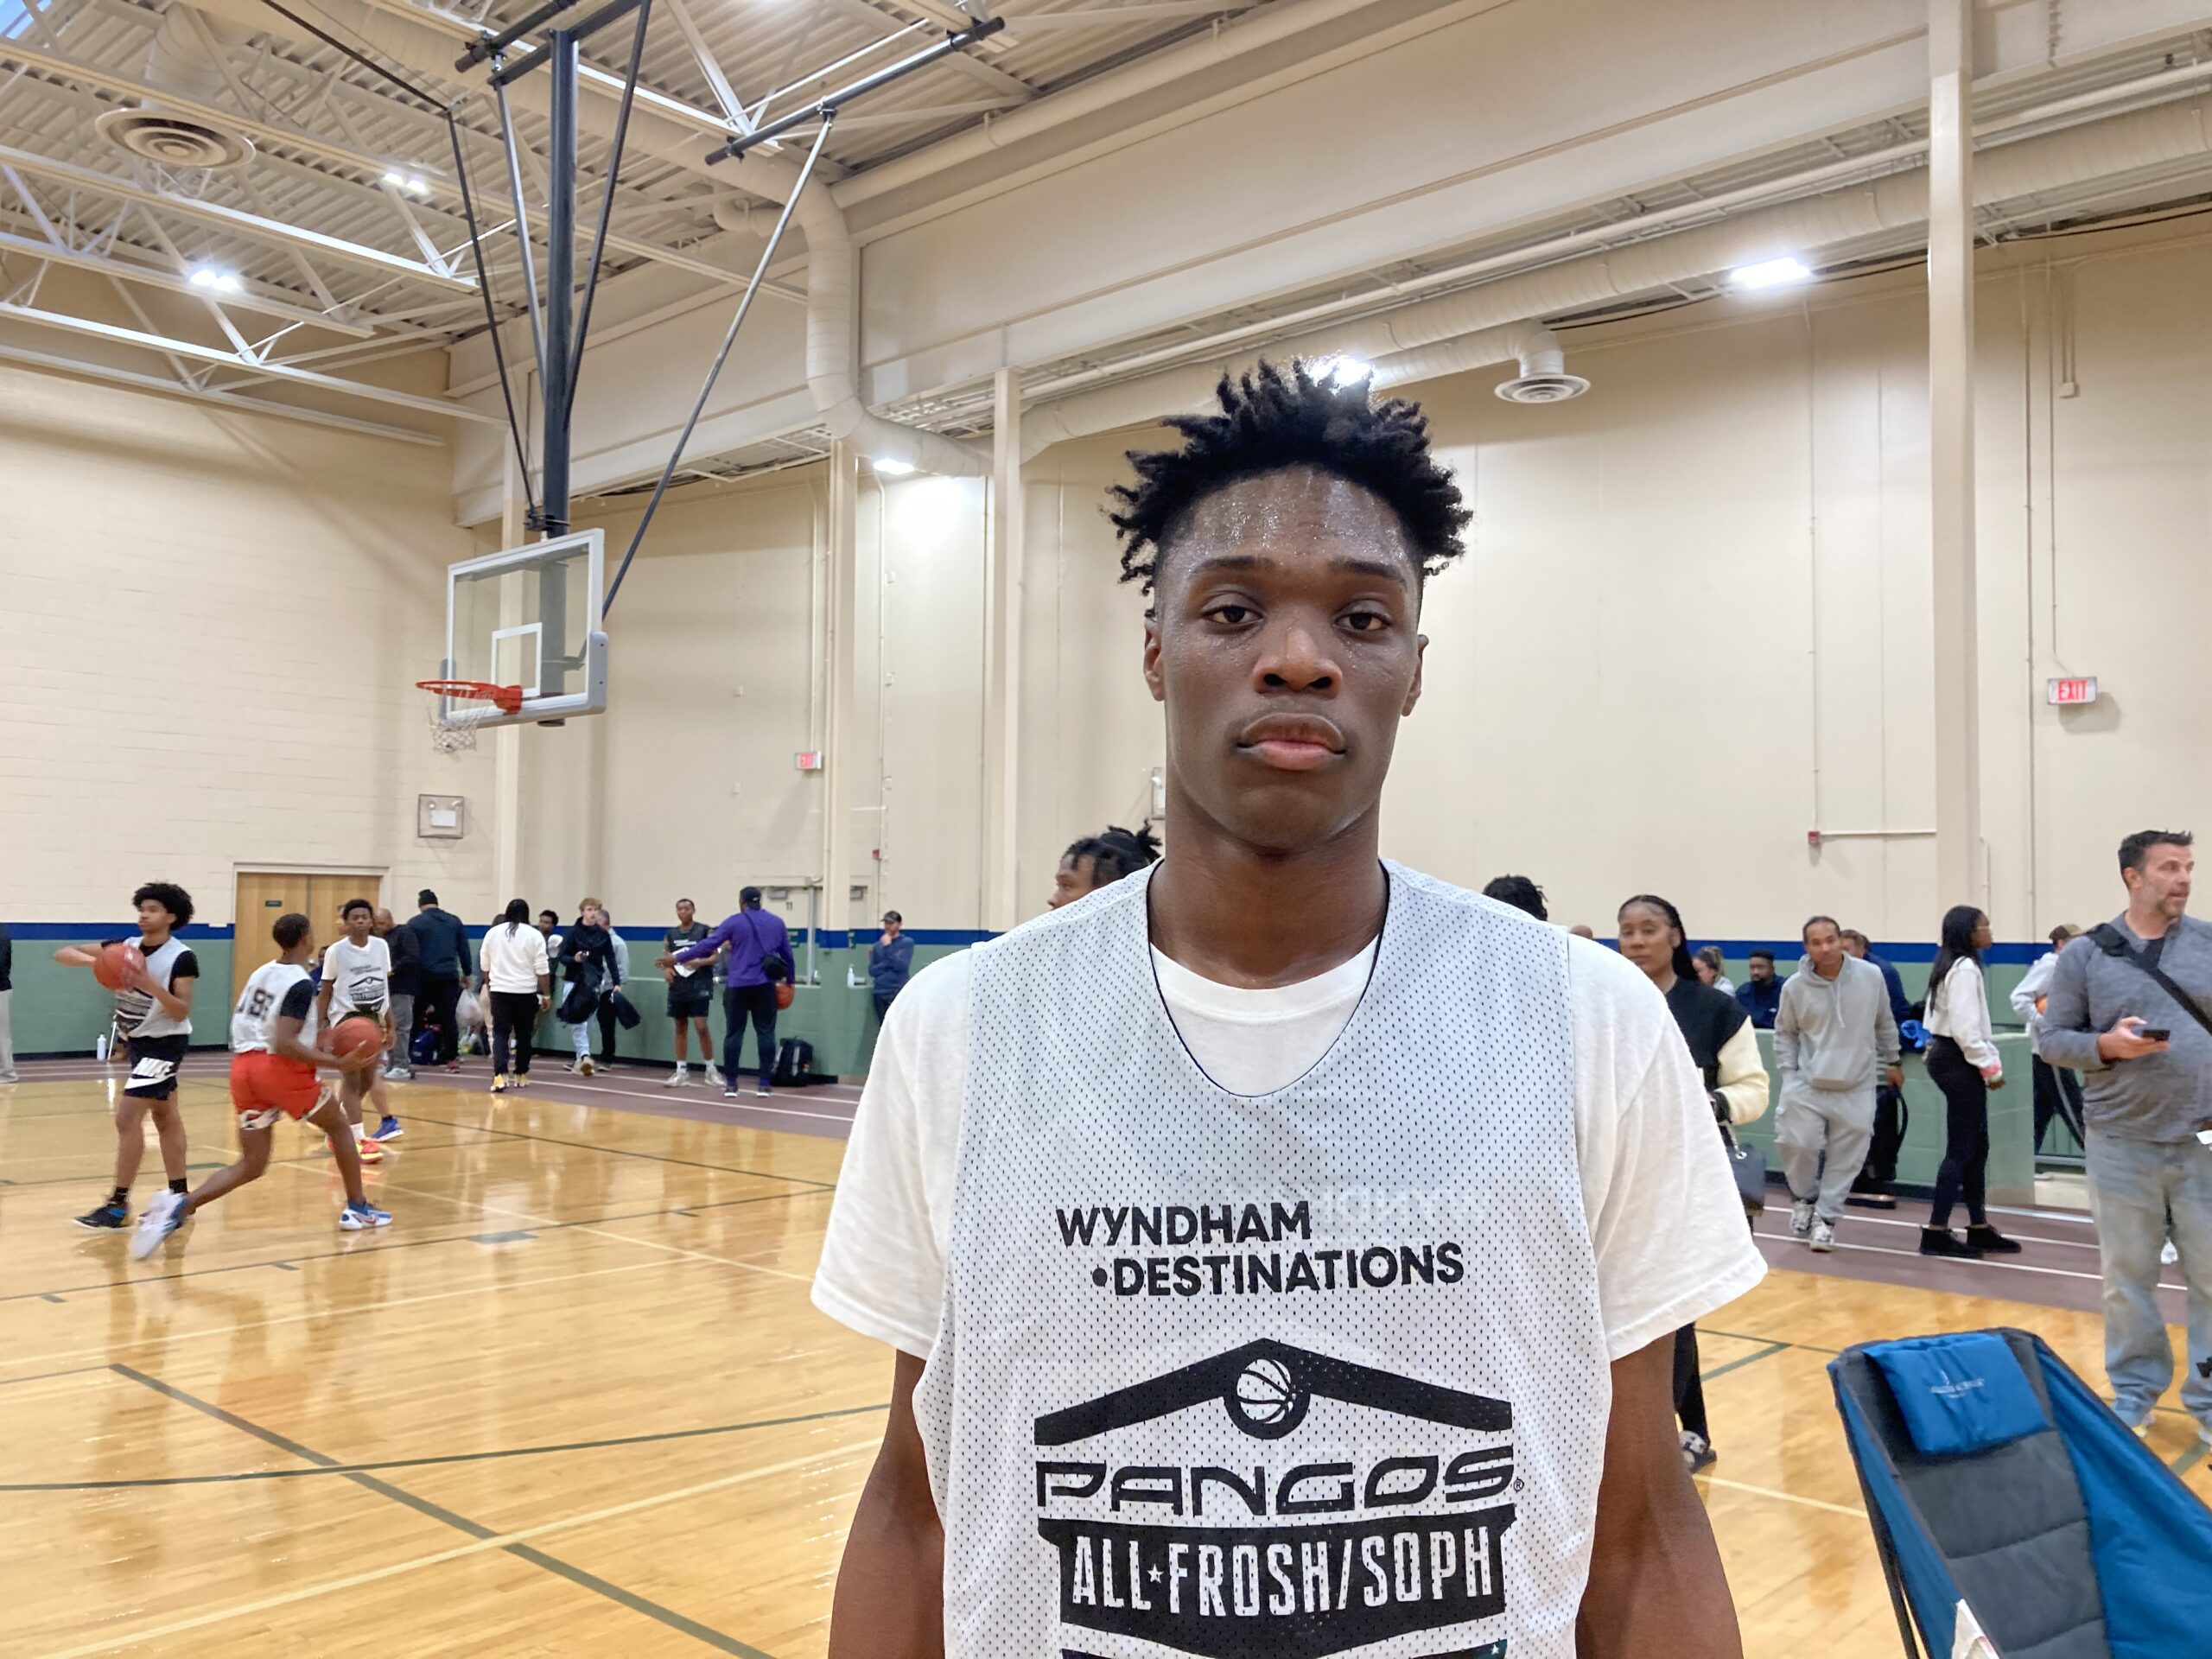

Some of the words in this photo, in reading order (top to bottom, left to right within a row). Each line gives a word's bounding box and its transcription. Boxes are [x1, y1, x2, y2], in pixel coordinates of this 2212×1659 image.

[2057, 679, 2088, 701] EXIT
[1056, 1200, 1313, 1248] WYNDHAM
[1114, 1241, 1465, 1296] DESTINATIONS
[1036, 1443, 1515, 1517] PANGOS
[1072, 1535, 1152, 1611] ALL
[1168, 1526, 1493, 1618] FROSH/SOPH
